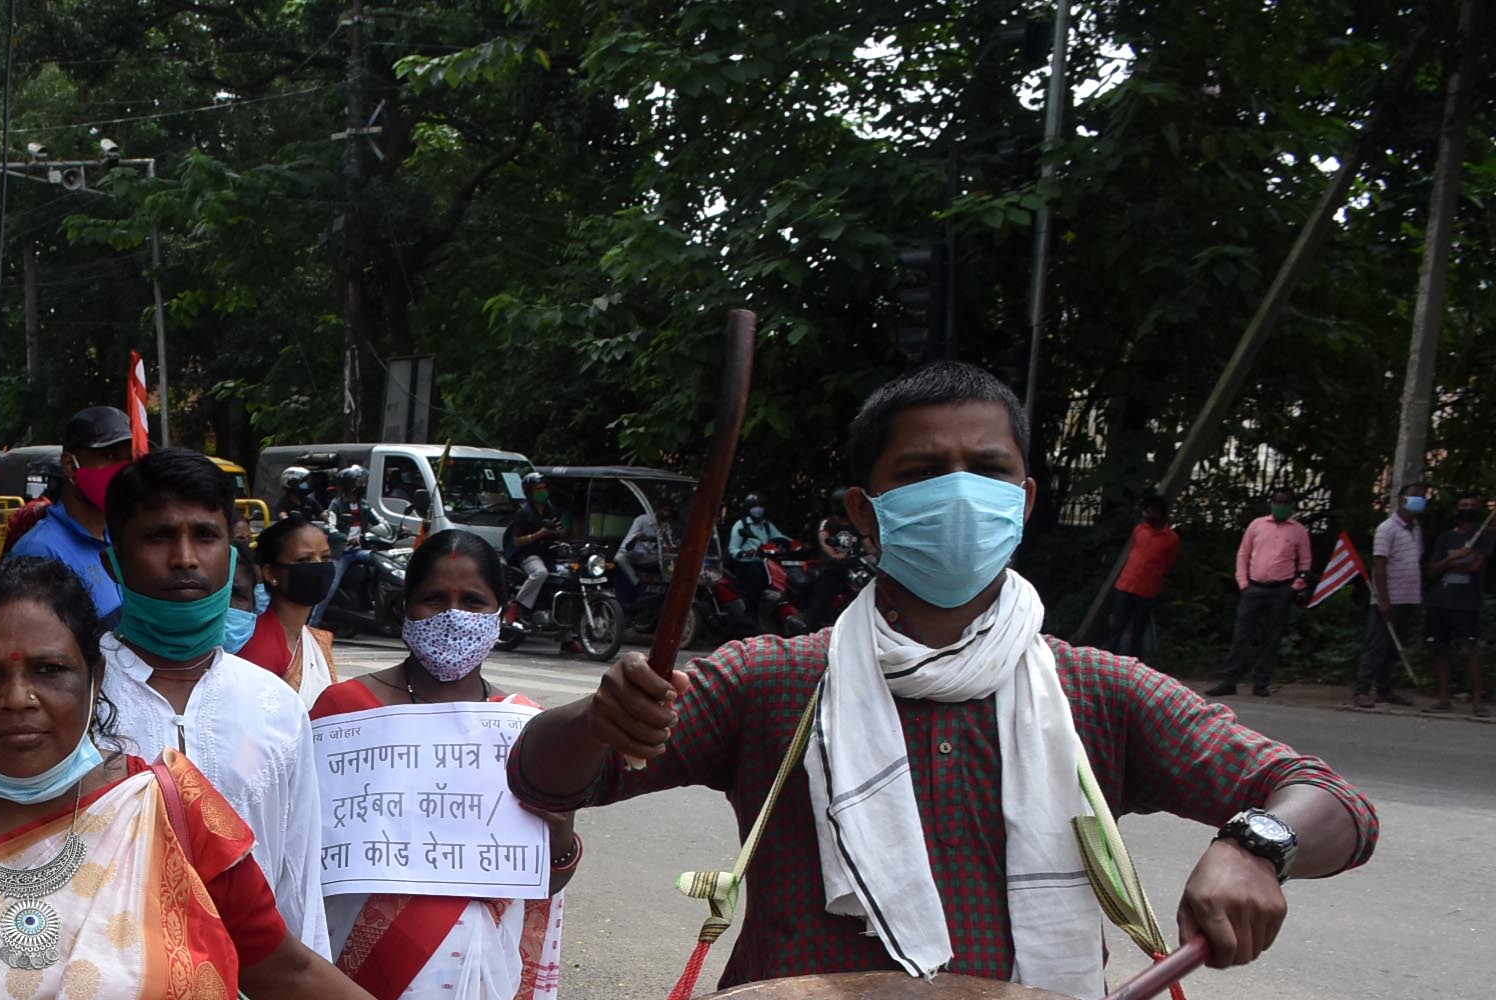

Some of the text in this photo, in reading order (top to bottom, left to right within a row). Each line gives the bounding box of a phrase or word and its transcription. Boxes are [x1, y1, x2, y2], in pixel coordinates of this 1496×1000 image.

[329, 727, 362, 739] जोहार
[480, 718, 501, 729] जय
[327, 732, 512, 776] जनगणना प्रपत्र में
[332, 783, 405, 829] ट्राईबल
[321, 842, 352, 871] रना
[362, 829, 411, 867] कोड
[422, 831, 466, 870] देना
